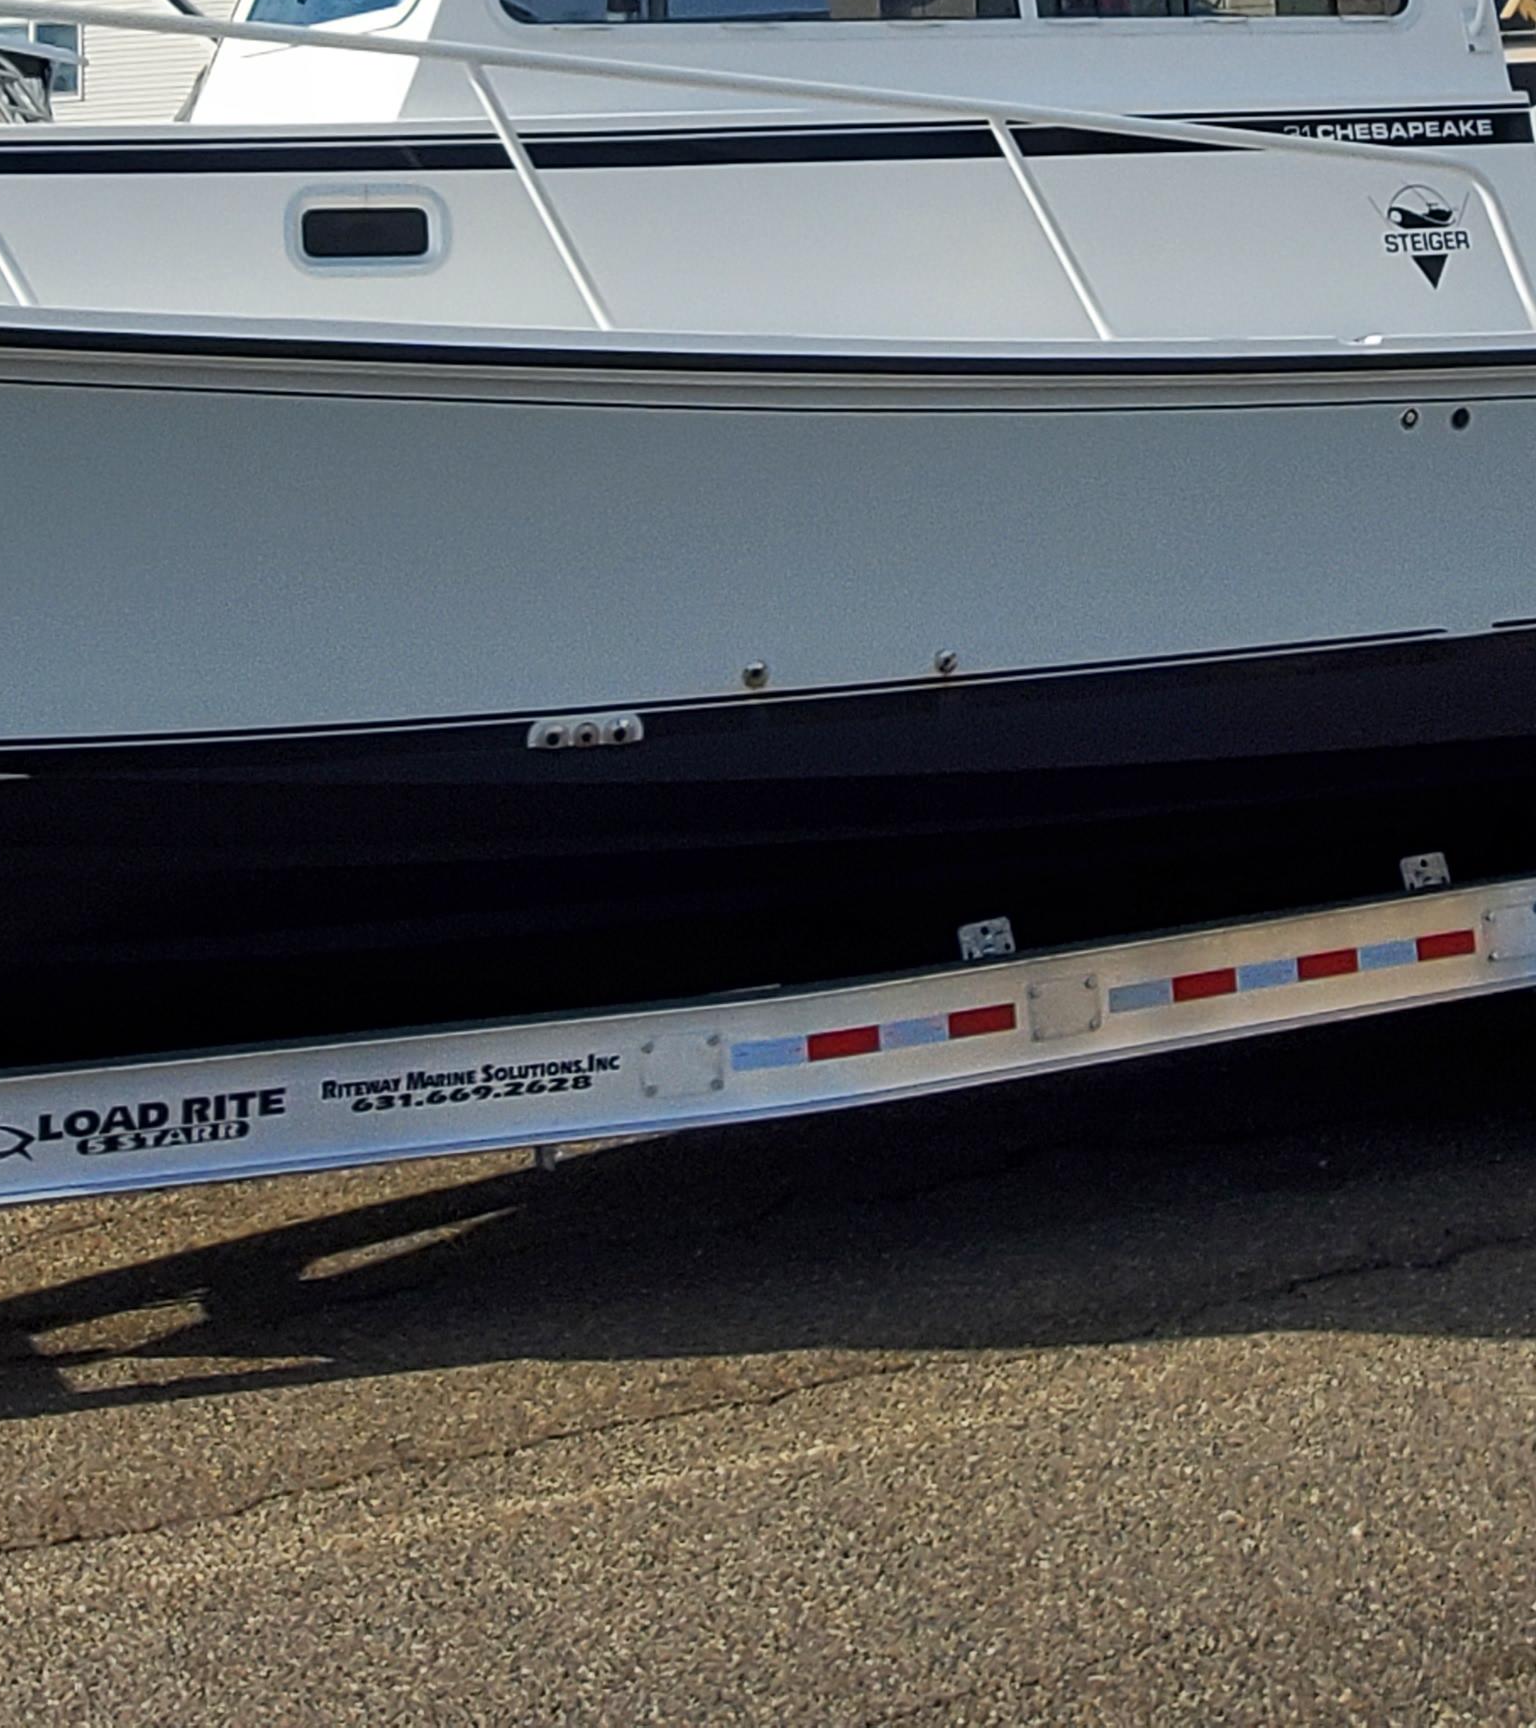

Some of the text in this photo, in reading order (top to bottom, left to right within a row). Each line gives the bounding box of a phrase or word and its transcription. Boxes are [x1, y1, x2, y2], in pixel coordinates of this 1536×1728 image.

[1316, 119, 1494, 140] CHESAPEAKE
[1384, 230, 1470, 253] STEIGER
[321, 1077, 401, 1100] RITEWAY
[406, 1069, 476, 1091] MARINE
[352, 1074, 593, 1113] 631.669.2628
[38, 1087, 287, 1141] LOAD RITE
